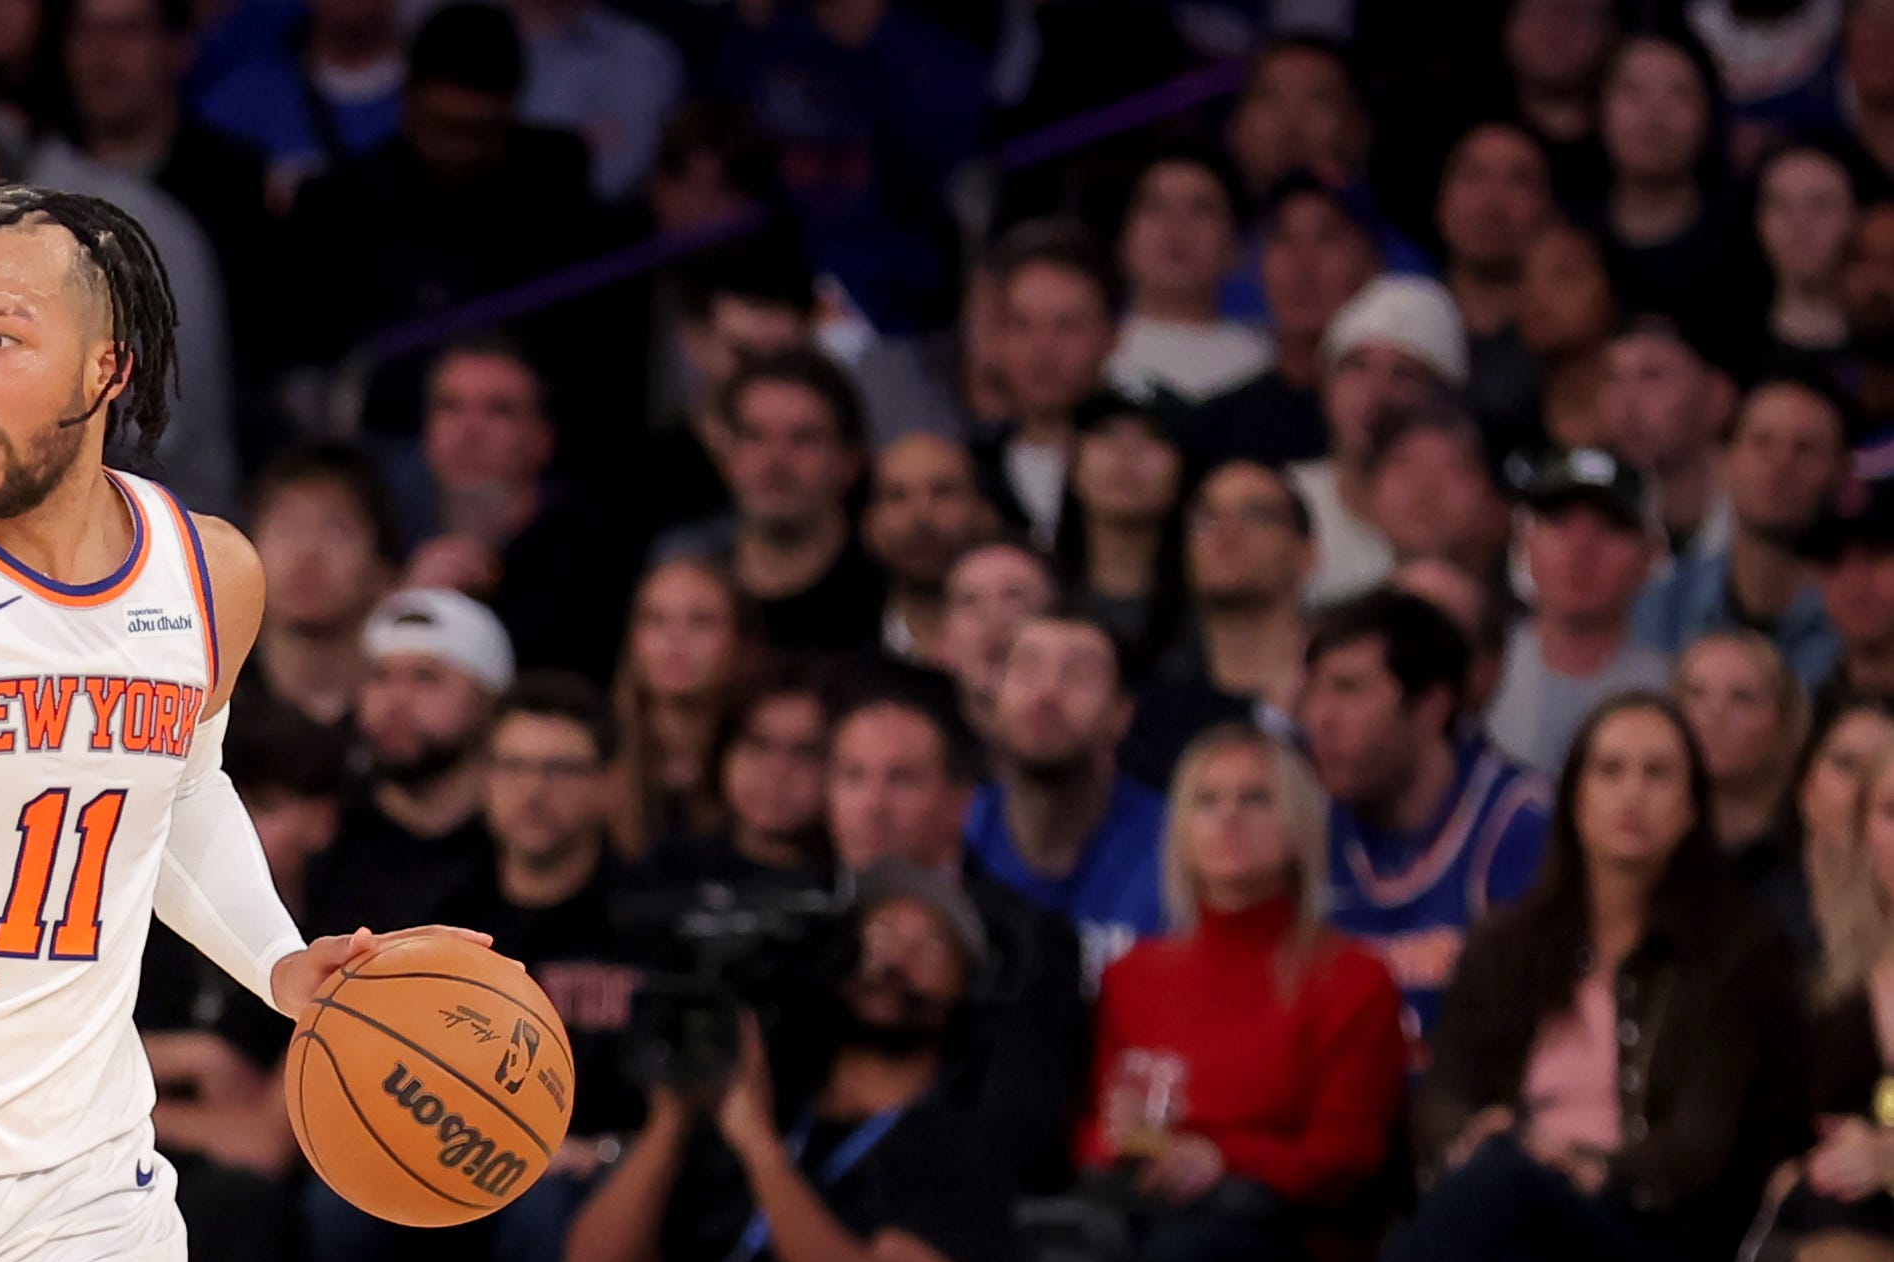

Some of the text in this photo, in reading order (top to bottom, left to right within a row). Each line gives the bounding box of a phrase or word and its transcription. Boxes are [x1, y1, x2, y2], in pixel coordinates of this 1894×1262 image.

[128, 613, 192, 632] abu dhabi
[83, 674, 205, 760] YORK
[382, 1060, 528, 1198] Wilson
